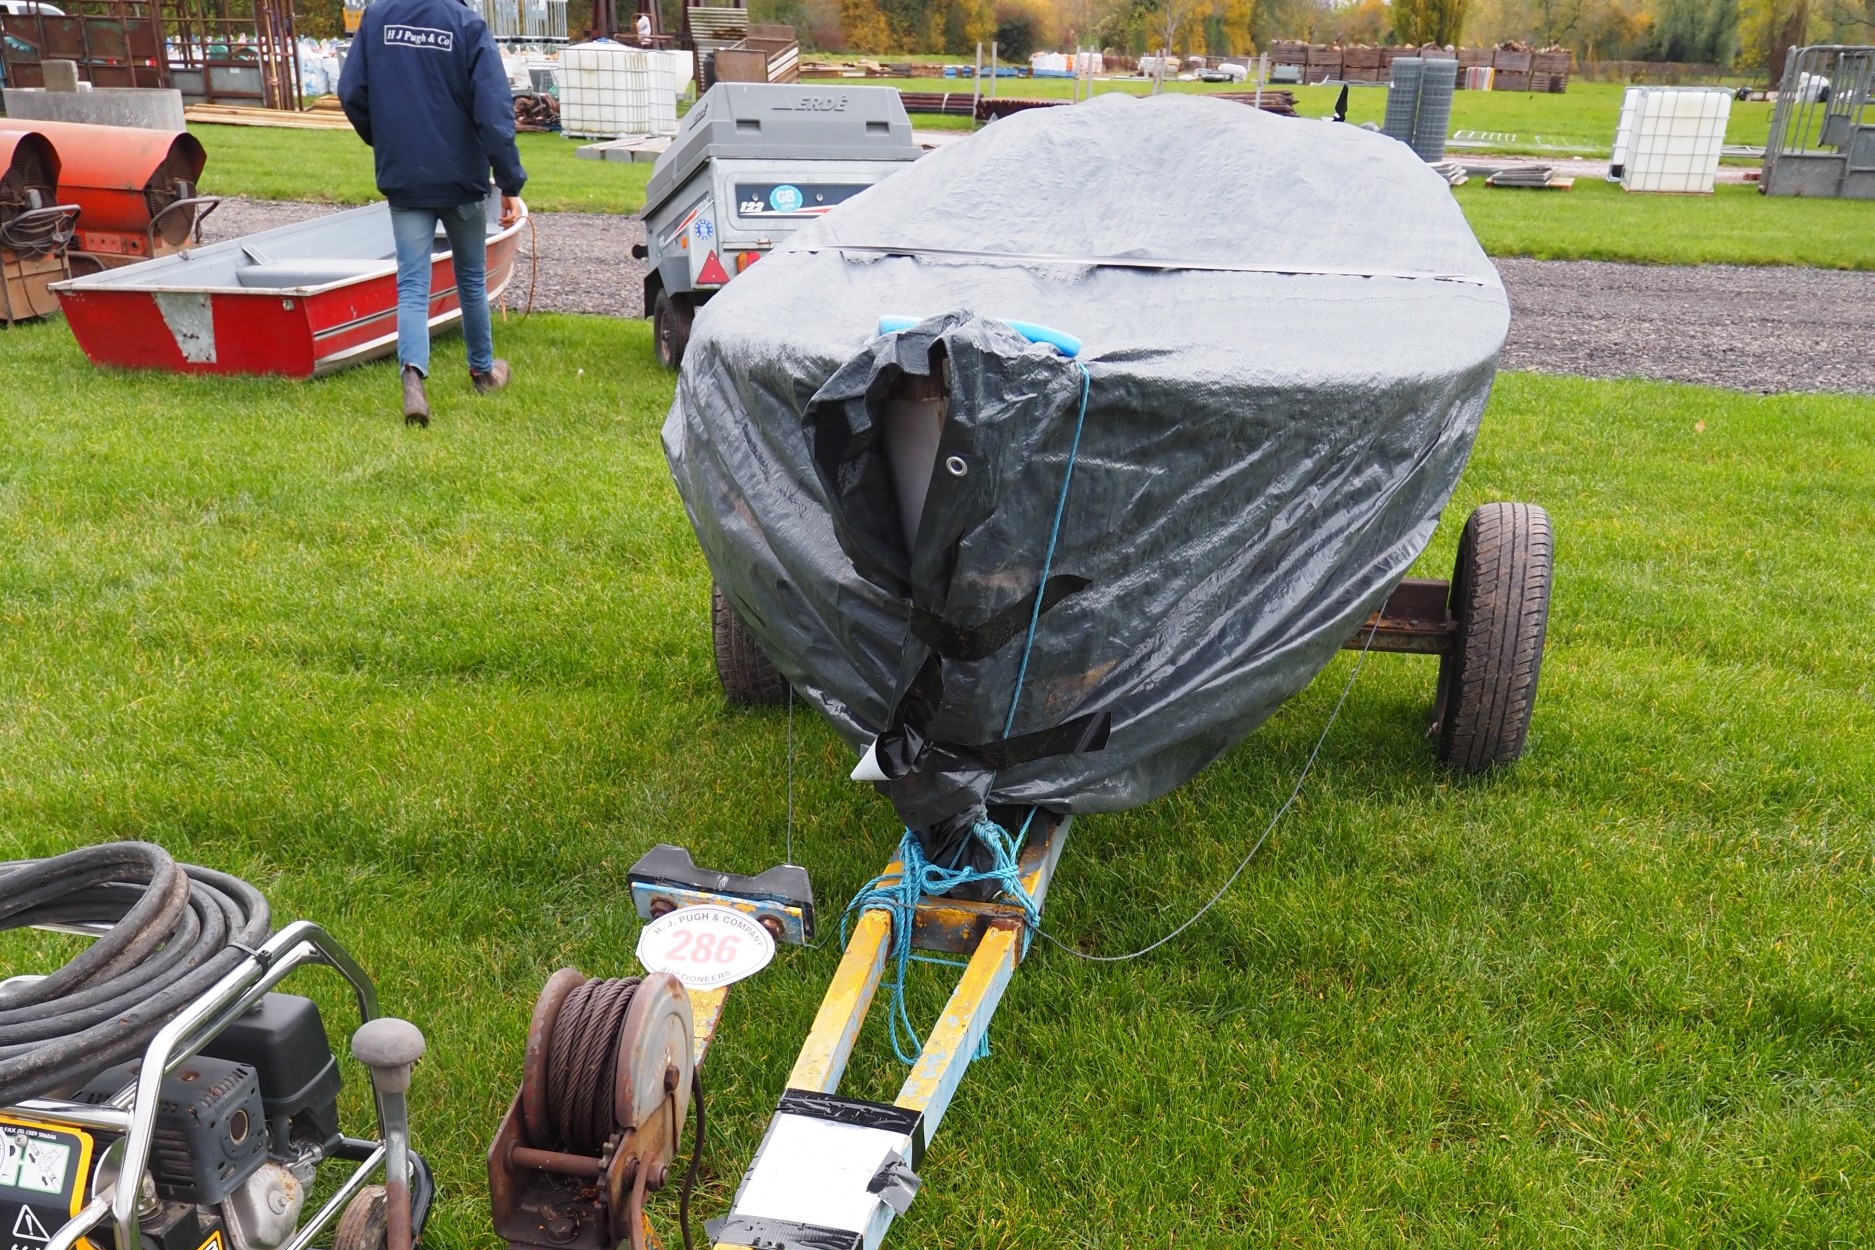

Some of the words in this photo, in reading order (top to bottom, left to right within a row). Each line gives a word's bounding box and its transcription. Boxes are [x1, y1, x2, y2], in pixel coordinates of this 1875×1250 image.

[387, 30, 395, 39] H
[396, 30, 403, 39] J
[404, 31, 426, 44] Pugh
[427, 33, 435, 43] &
[438, 35, 450, 45] Co
[776, 189, 796, 203] GB
[740, 201, 765, 213] 122
[678, 912, 709, 923] PUGH
[712, 913, 719, 922] &
[723, 915, 764, 947] COMPANY
[664, 929, 741, 964] 286
